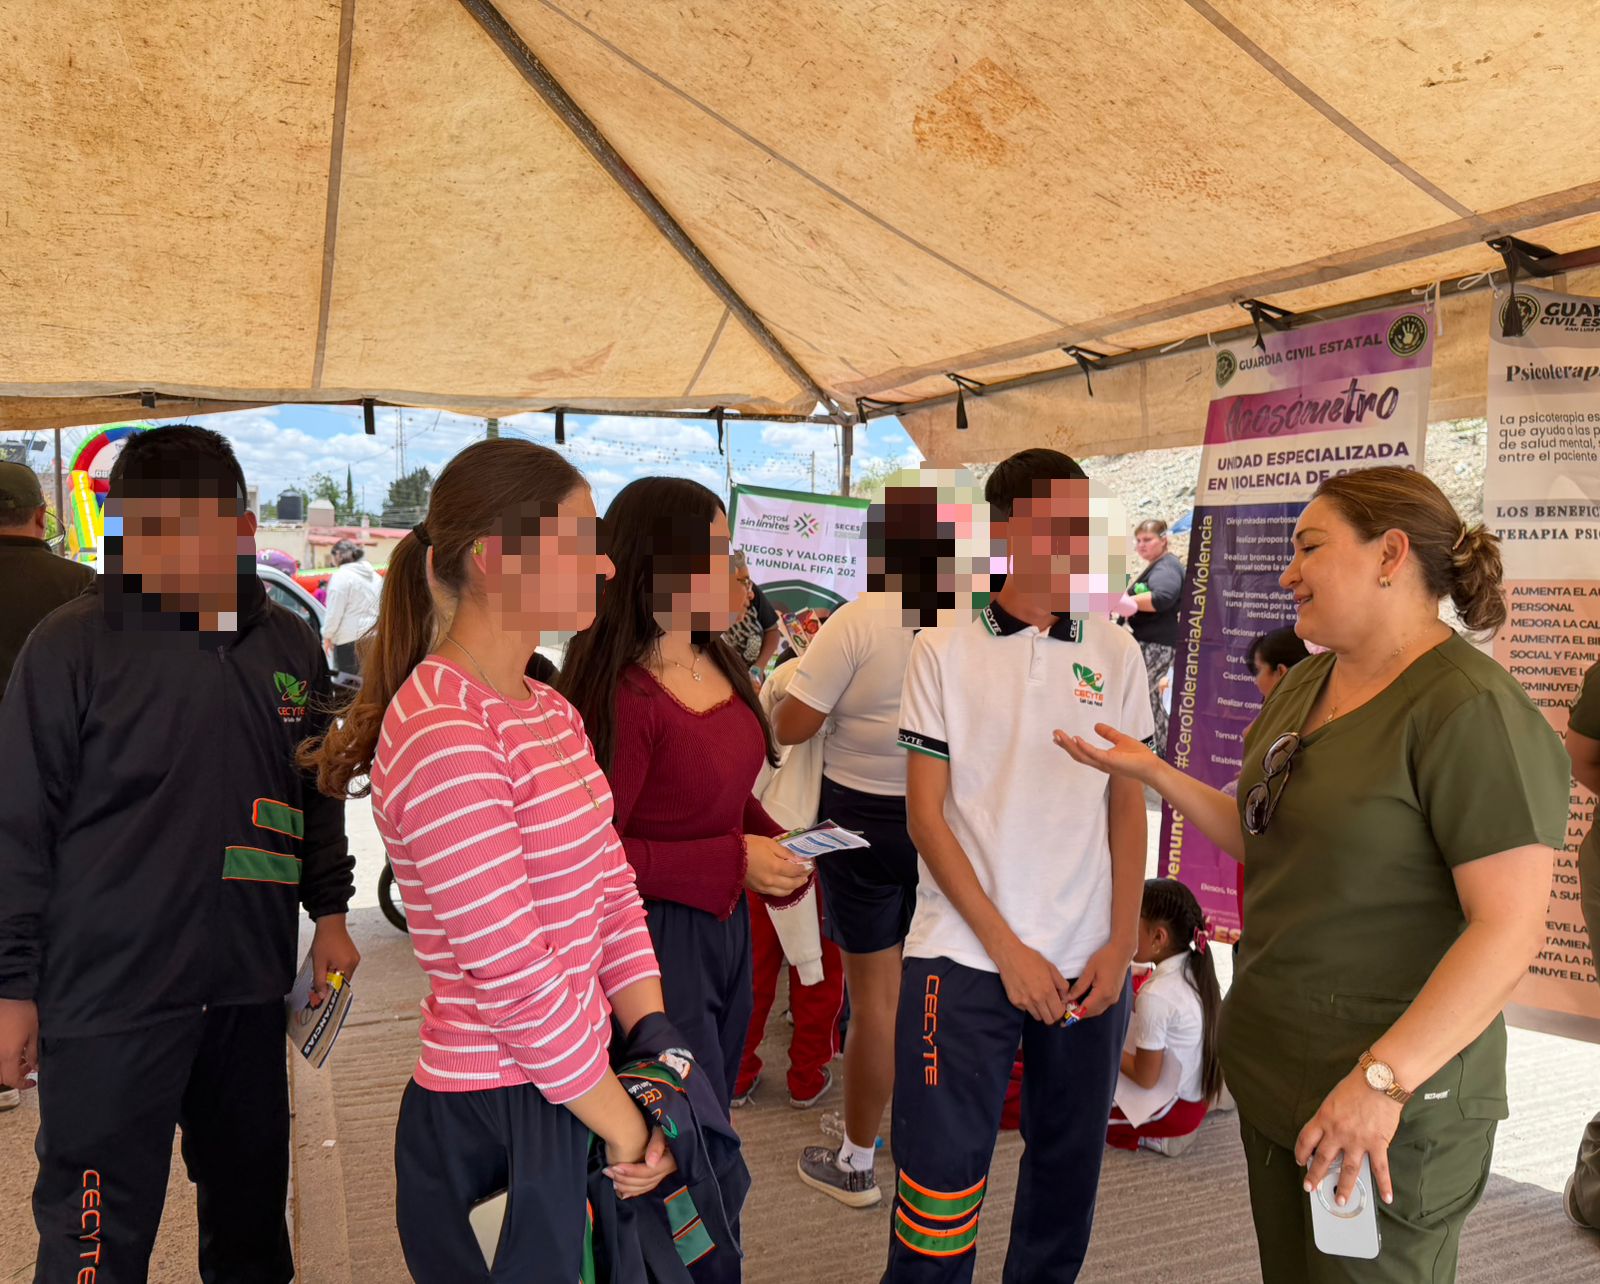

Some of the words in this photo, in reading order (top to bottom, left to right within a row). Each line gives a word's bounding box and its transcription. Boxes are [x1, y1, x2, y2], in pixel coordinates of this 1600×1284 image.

[1540, 316, 1577, 326] CIVIL
[1239, 353, 1282, 371] GUARDIA
[1286, 347, 1317, 361] CIVIL
[1319, 333, 1383, 355] ESTATAL
[1506, 362, 1600, 381] Psicoterap
[1500, 415, 1514, 425] La
[1519, 411, 1584, 427] psicoterapia
[1499, 428, 1526, 438] que
[1530, 425, 1564, 438] ayuda
[1567, 427, 1573, 435] a
[1575, 425, 1590, 436] las
[1499, 439, 1516, 450] de
[1521, 438, 1556, 450] salud
[1559, 438, 1596, 450] mental,
[1266, 441, 1409, 466] ESPECIALIZADA
[1498, 452, 1535, 462] entre
[1539, 451, 1550, 461] el
[1554, 450, 1597, 463] paciente
[1207, 477, 1228, 491] EN
[1496, 506, 1529, 518] LOS
[1496, 529, 1569, 540] TERAPIA
[786, 549, 794, 557] Y
[796, 550, 848, 564] VALORES
[1249, 553, 1276, 562] bromas
[755, 558, 807, 572] MUNDIAL
[810, 564, 834, 575] FIFA
[1511, 586, 1571, 597] AUMENTA
[1573, 587, 1587, 597] EL
[1511, 602, 1574, 613] PERSONAL
[1510, 618, 1561, 629] MEJORA
[1563, 619, 1577, 629] LA
[1174, 514, 1213, 768] #CeroToleranciaALaViolencia
[1509, 634, 1570, 645] AUMENTA
[1572, 635, 1585, 646] EL
[1509, 650, 1551, 660] SOCIAL
[1554, 651, 1562, 660] Y
[1509, 665, 1577, 676] PROMUEVE
[1568, 828, 1584, 837] LA
[1557, 859, 1573, 868] LA
[1565, 954, 1580, 966] LA
[1570, 971, 1584, 982] EL
[923, 974, 940, 1086] CECYTE
[77, 1169, 101, 1284] CECYTE
